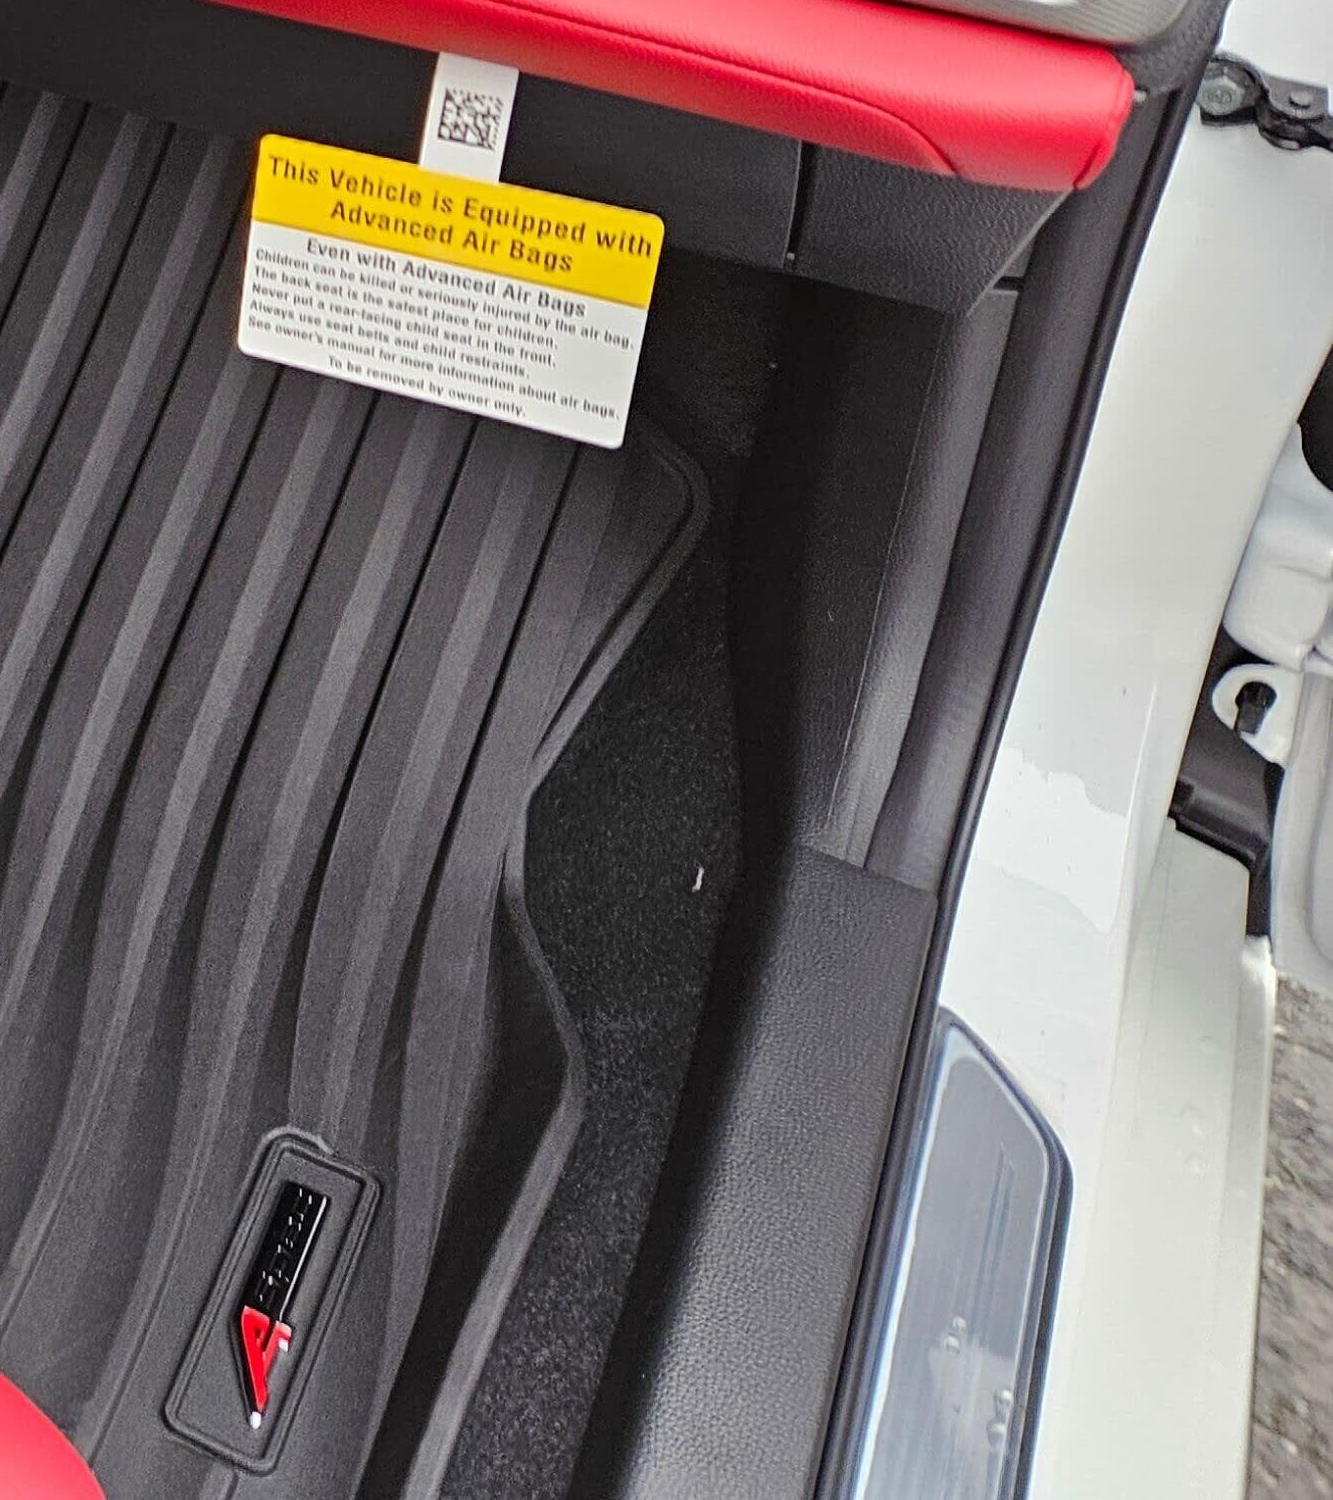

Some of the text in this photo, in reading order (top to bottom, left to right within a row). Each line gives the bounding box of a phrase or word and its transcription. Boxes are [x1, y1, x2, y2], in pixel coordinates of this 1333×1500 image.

[269, 155, 652, 259] This Vehicle is Equipped with
[330, 200, 573, 272] Advanced Air Bags
[254, 264, 558, 351] The back seat is the safest place for children.
[256, 247, 635, 351] Children can be killed or seriously injured by the air bag.
[307, 237, 586, 318] Even with Advanced Air Bags
[248, 314, 271, 332] See
[327, 337, 376, 358] manual
[378, 347, 397, 363] for
[400, 355, 434, 373] more
[438, 364, 515, 393] information
[518, 384, 557, 405] about
[560, 395, 580, 410] air
[583, 398, 620, 421] bags.
[249, 299, 529, 380] Always use seat belts and child restraints.
[251, 282, 556, 369] Never put a rear-facing child seat in the front.
[328, 355, 526, 418] To be removed by owner only.
